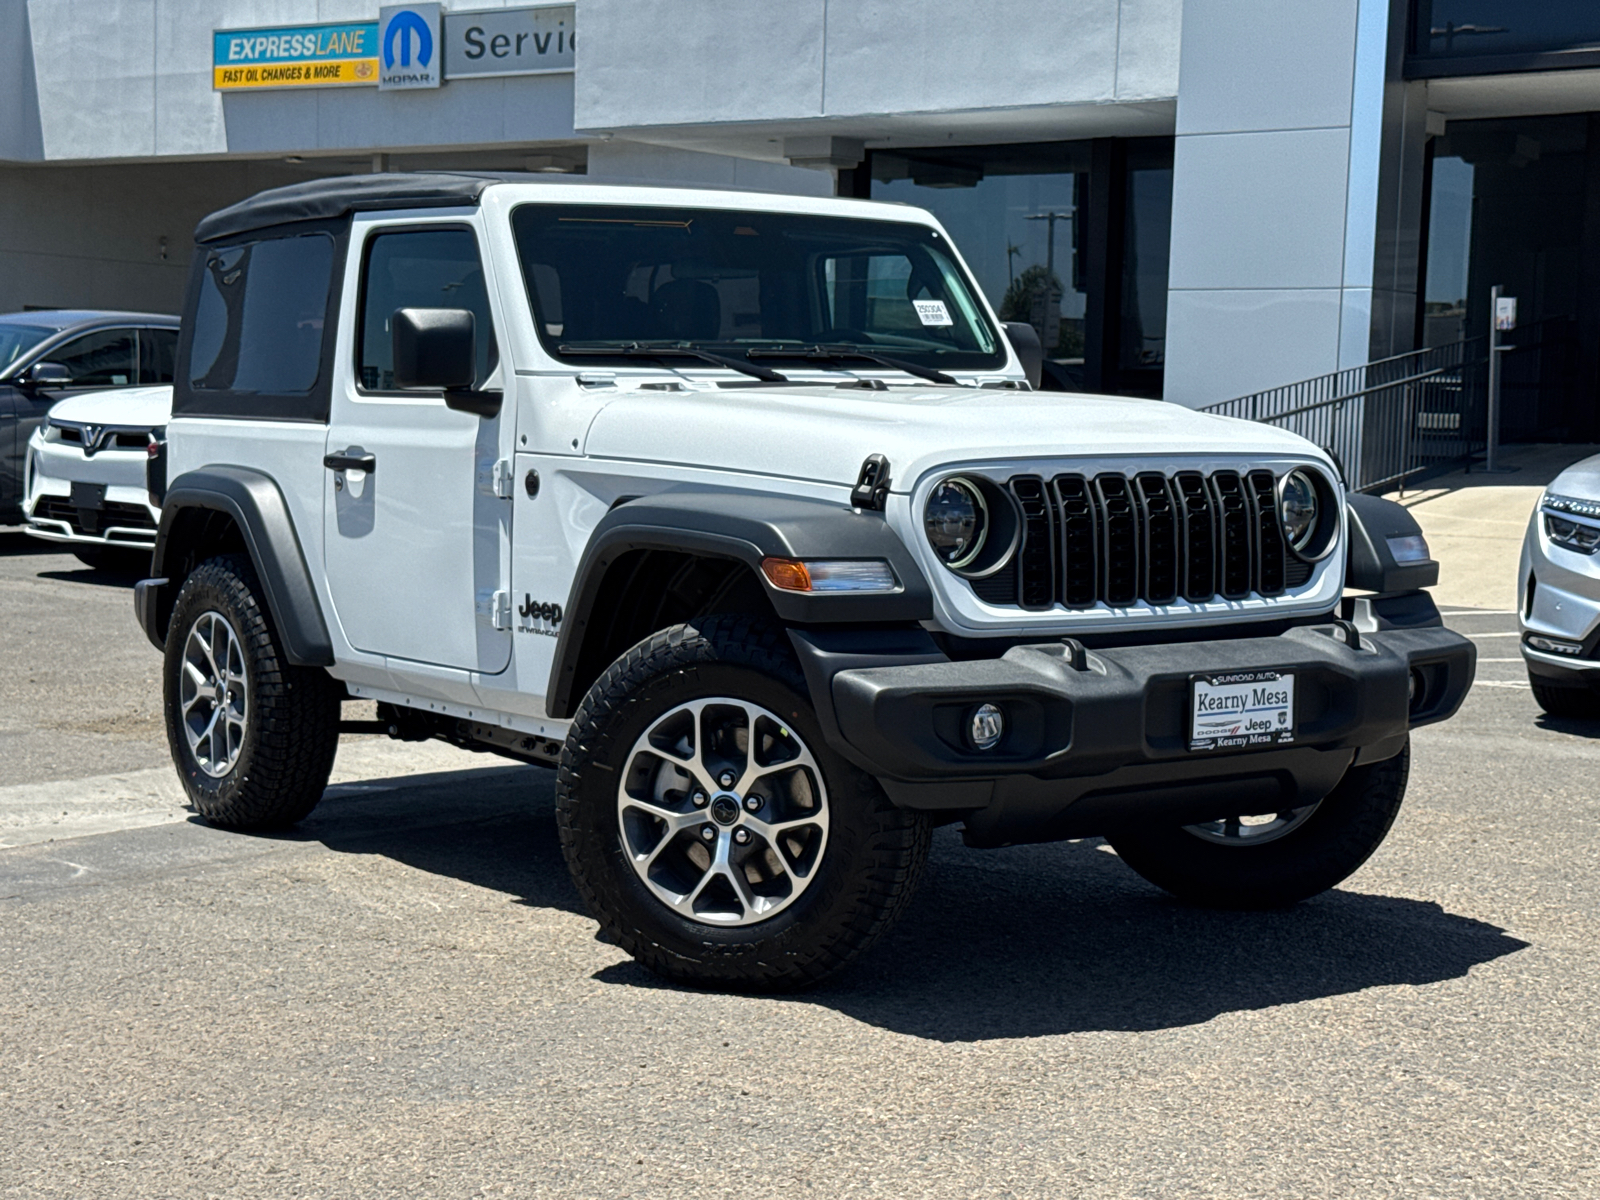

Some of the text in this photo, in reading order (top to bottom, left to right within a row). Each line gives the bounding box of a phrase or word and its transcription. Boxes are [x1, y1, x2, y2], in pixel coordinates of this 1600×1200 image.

[464, 20, 575, 60] Servi
[222, 65, 341, 83] FAST OIL CHANGES & MORE
[382, 73, 430, 85] MOPAR
[518, 593, 562, 627] Jeep
[1217, 672, 1276, 683] SUNROAD AUTO
[1197, 688, 1288, 714] Kearny Mesa
[1244, 718, 1272, 732] Jeep
[1217, 737, 1248, 747] Kearny
[1249, 734, 1272, 744] Mesa
